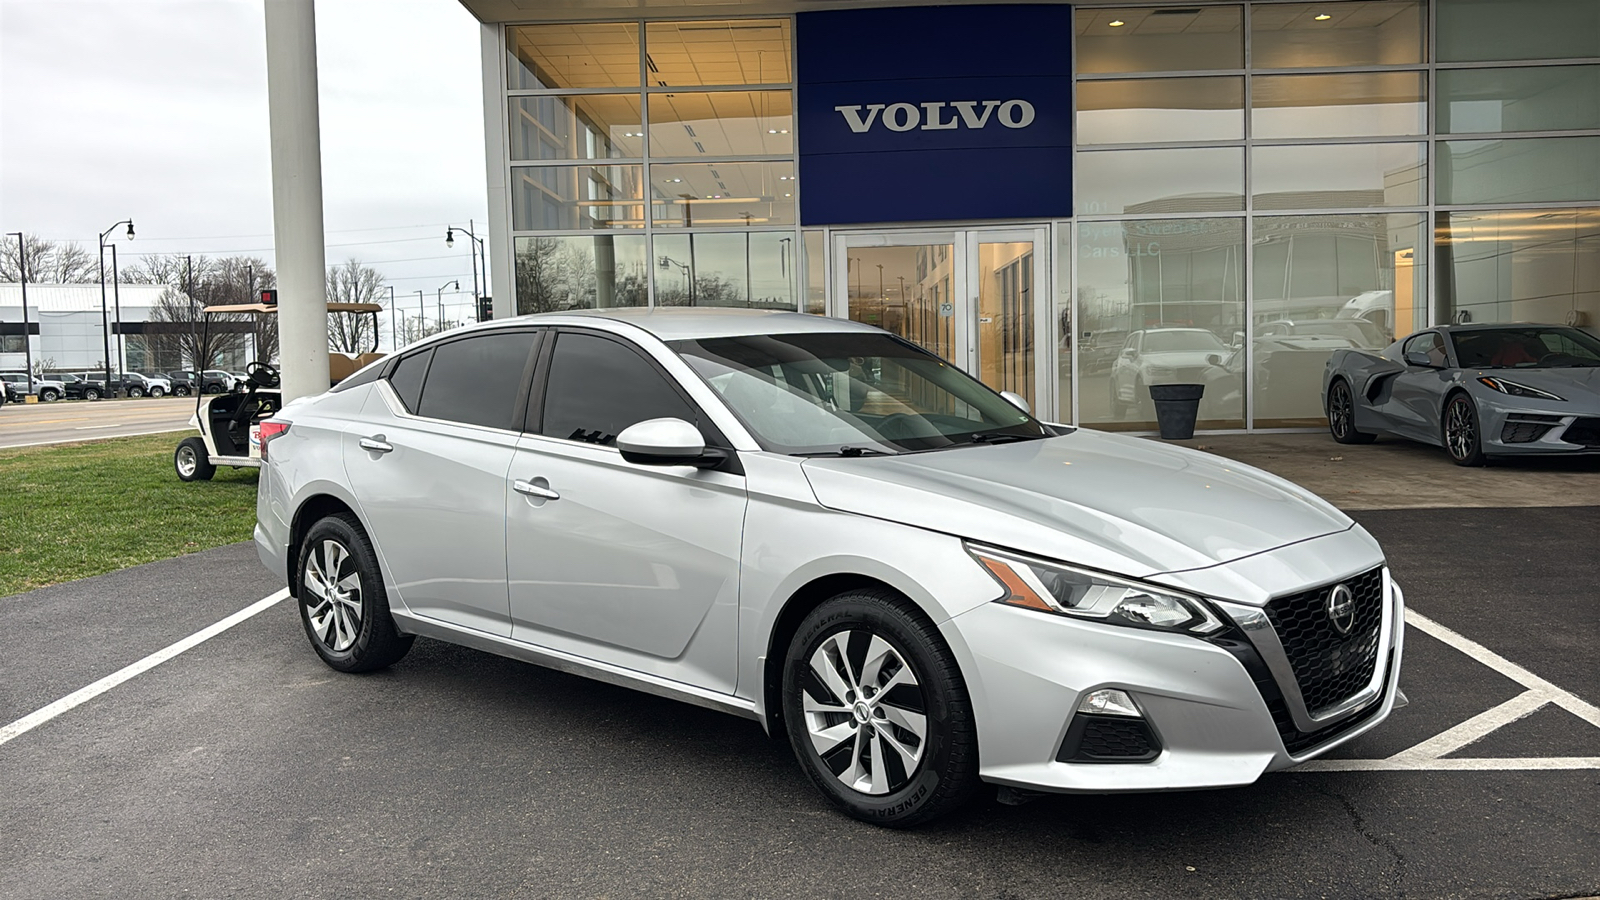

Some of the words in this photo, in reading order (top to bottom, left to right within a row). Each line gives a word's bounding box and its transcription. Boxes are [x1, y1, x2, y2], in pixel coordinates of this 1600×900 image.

[835, 99, 1035, 133] VOLVO
[1080, 244, 1119, 258] Cars
[1128, 241, 1160, 257] LLC
[867, 784, 928, 818] GENERAL
